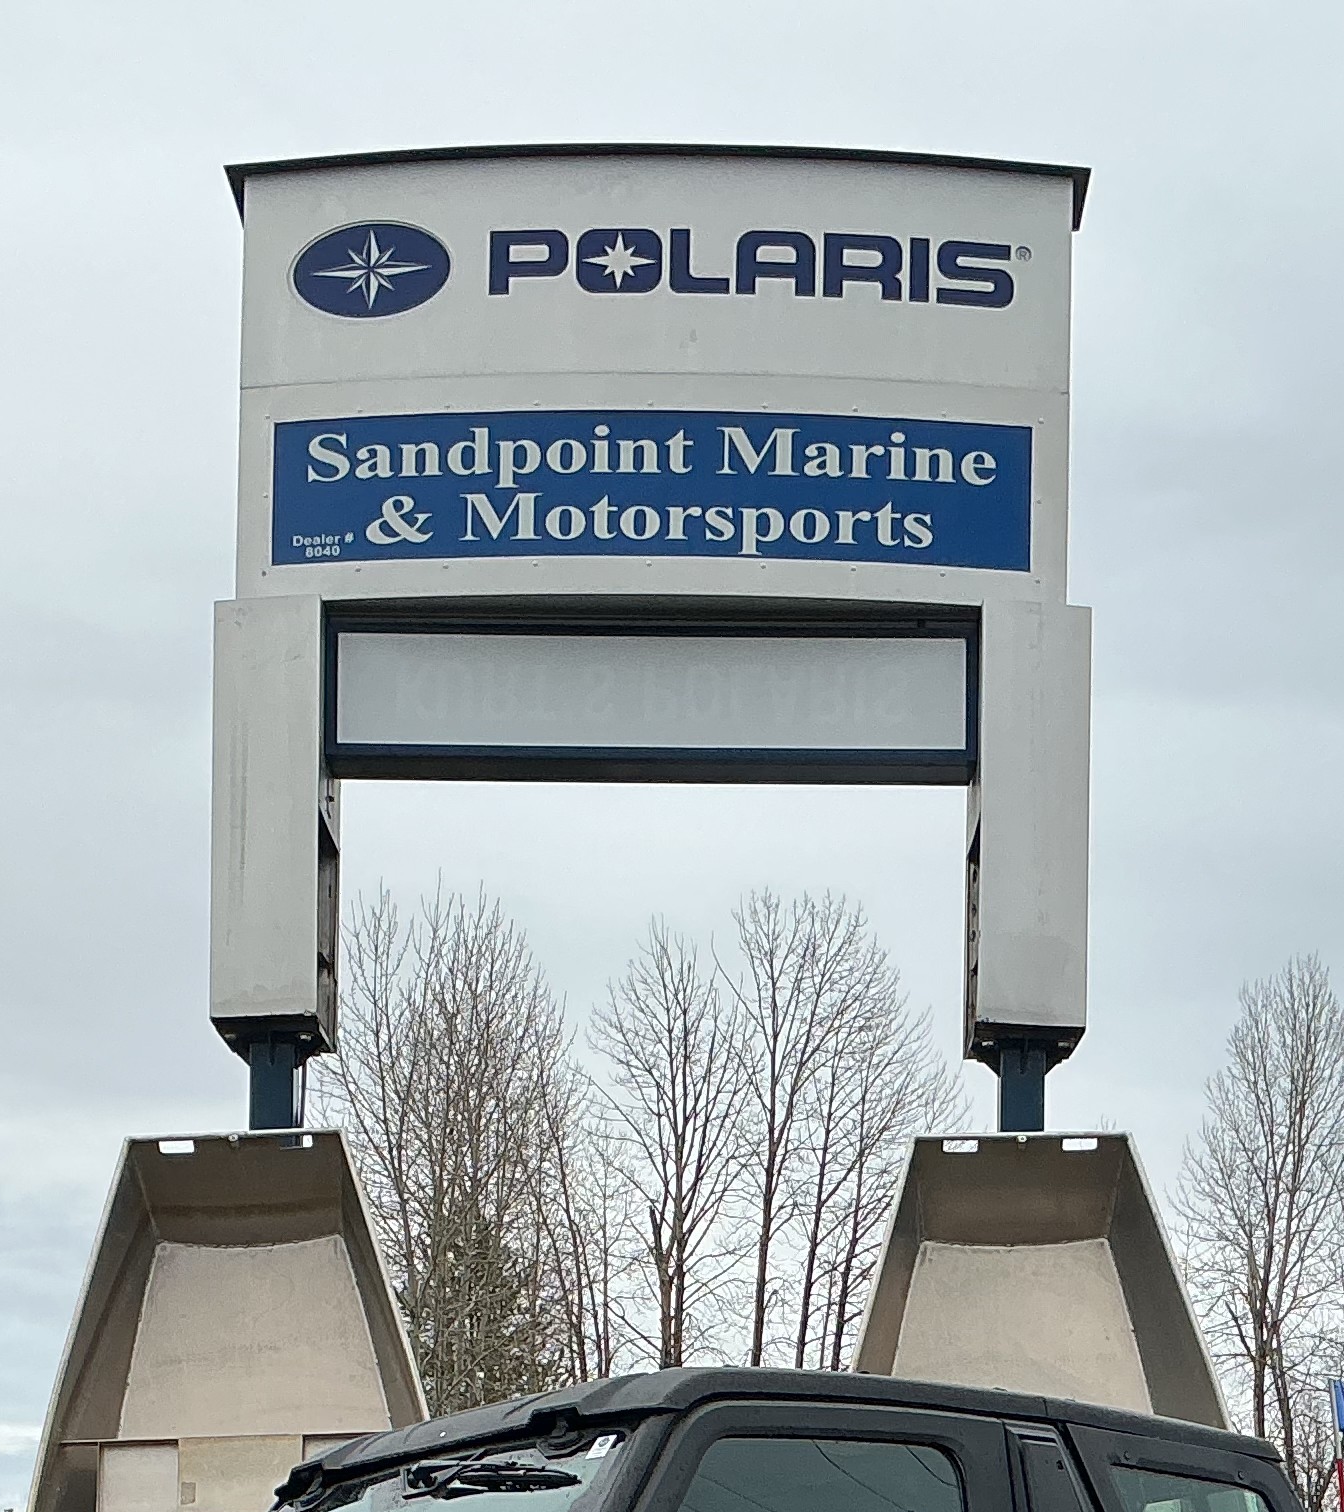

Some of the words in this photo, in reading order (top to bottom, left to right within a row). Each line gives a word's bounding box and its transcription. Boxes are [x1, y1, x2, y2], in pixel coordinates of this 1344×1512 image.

[488, 228, 1015, 309] POLARIS
[306, 424, 694, 489] Sandpoint
[716, 426, 998, 486] Marine
[292, 533, 341, 547] Dealer
[305, 545, 341, 558] 8040
[364, 494, 434, 546] &
[458, 492, 935, 556] Motorsports
